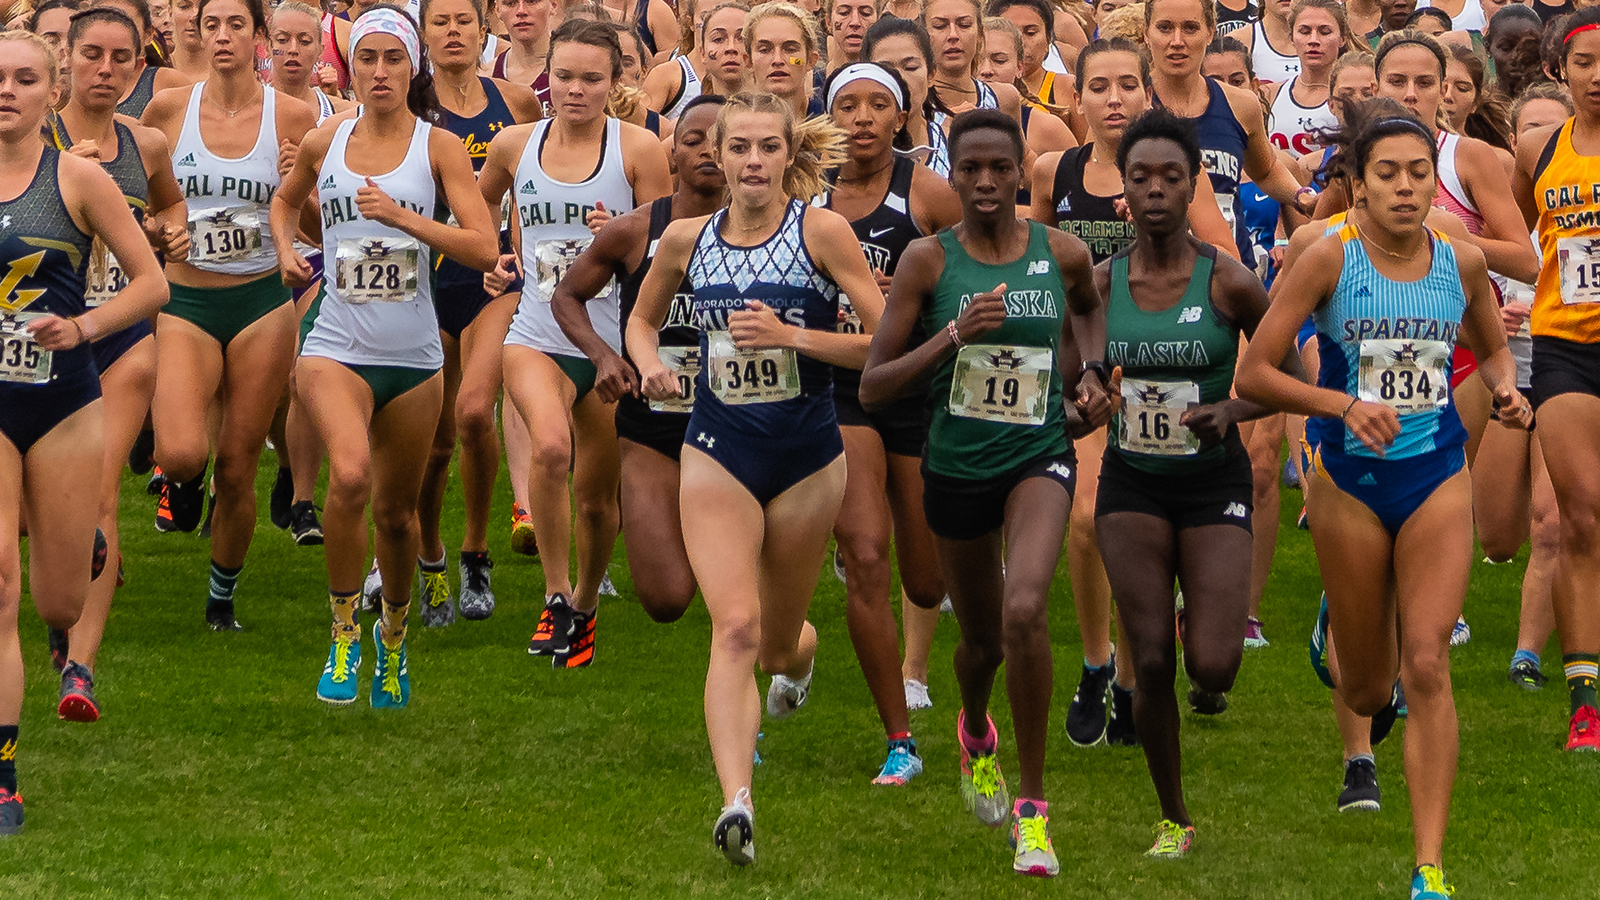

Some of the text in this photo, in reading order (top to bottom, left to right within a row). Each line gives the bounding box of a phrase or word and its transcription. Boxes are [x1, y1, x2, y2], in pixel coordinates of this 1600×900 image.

[178, 175, 276, 204] AL POLY
[1545, 185, 1585, 210] CAL
[321, 196, 358, 230] CAL
[520, 202, 557, 228] CAL
[203, 228, 247, 255] 130
[353, 263, 401, 290] 128
[957, 290, 1059, 319] ASKA
[0, 339, 40, 369] 35
[1107, 340, 1210, 366] ALASKA
[725, 358, 778, 390] 349
[1380, 370, 1432, 400] 834
[982, 376, 1020, 407] 19
[1138, 411, 1170, 441] 16
